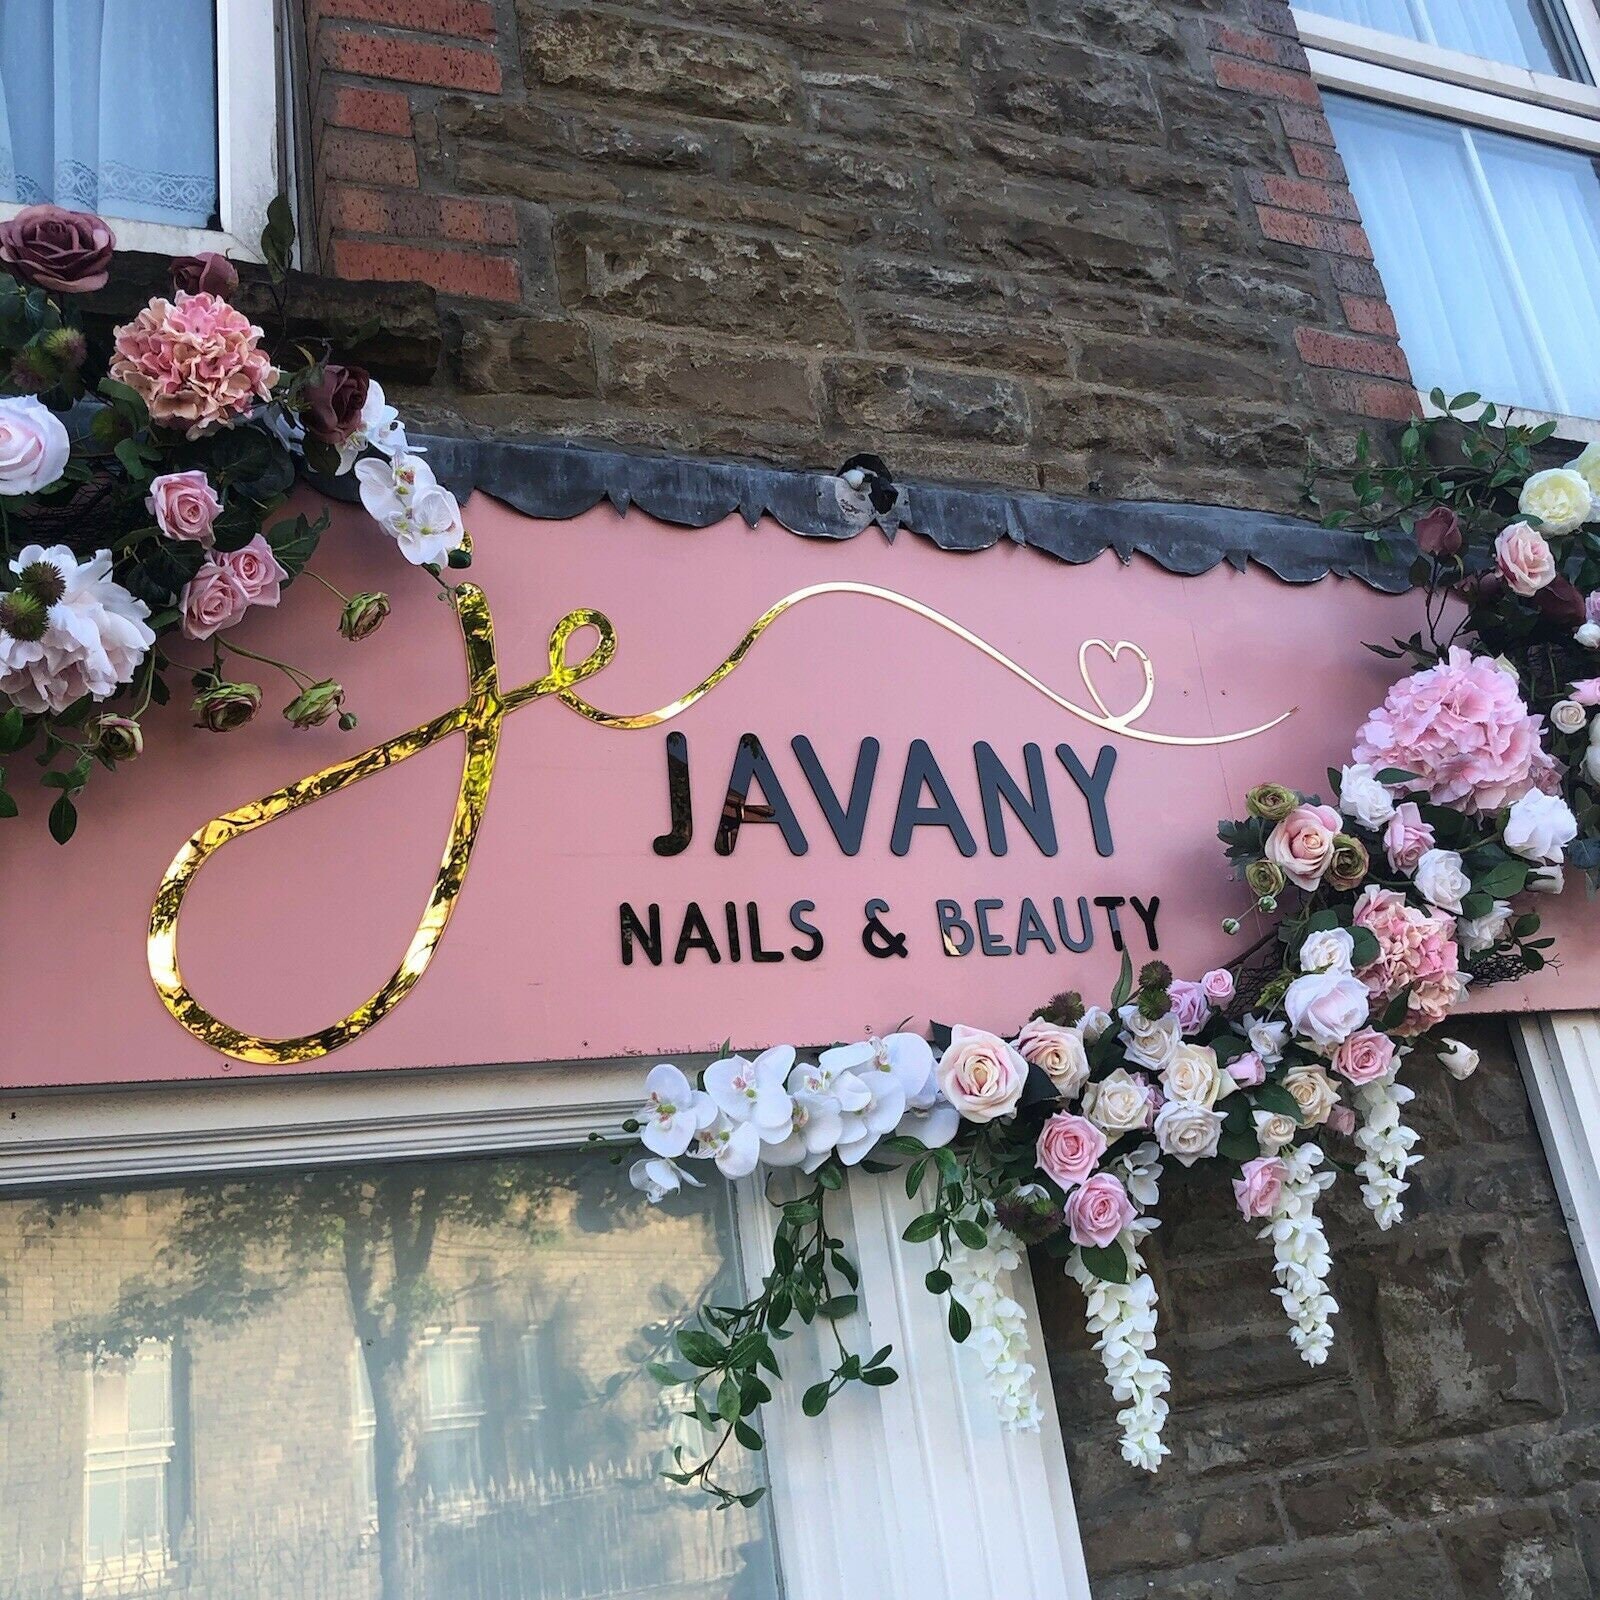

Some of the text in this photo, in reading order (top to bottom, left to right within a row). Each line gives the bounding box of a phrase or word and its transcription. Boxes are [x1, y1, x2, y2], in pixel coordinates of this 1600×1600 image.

[652, 731, 1117, 857] JAVANY
[619, 896, 1161, 966] NAILS & BEAUTY
